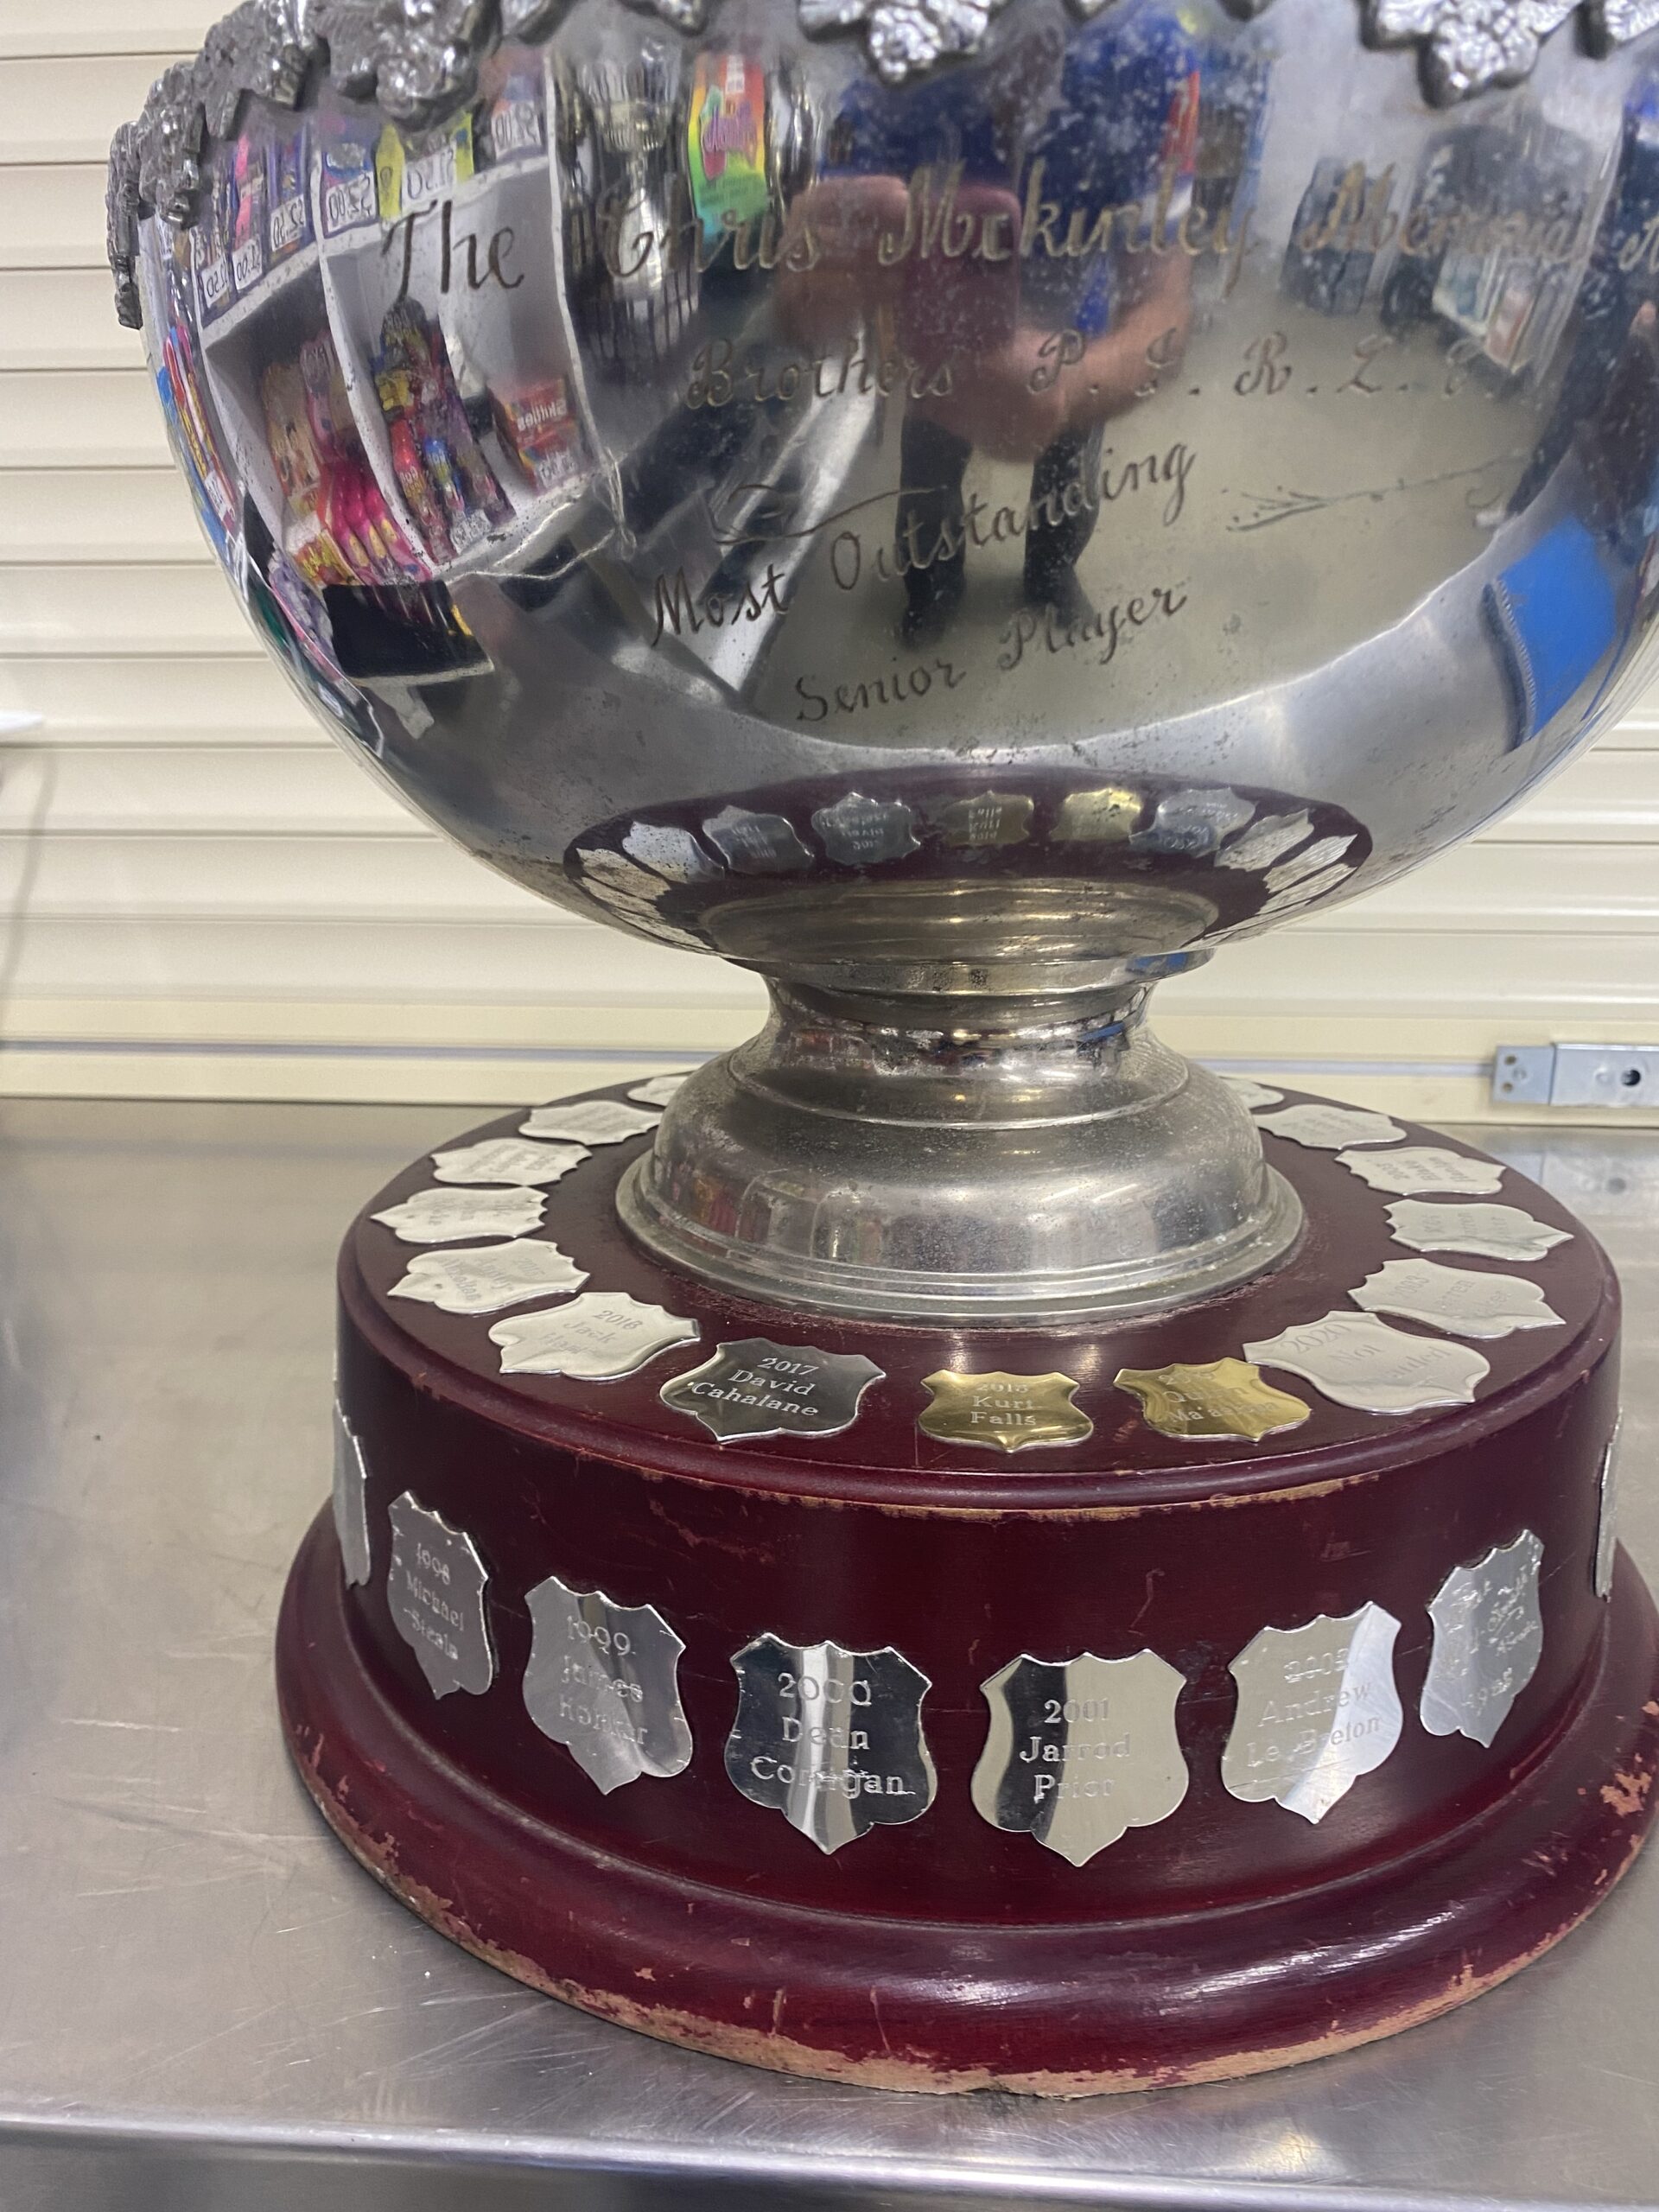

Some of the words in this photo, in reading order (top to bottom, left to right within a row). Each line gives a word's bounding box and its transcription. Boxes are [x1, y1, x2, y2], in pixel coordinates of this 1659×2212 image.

[381, 200, 525, 303] The
[685, 339, 953, 409] Brothers
[652, 563, 790, 647] Most
[830, 441, 1197, 589] Outstanding
[796, 657, 967, 721] Senior
[998, 582, 1189, 664] Player
[563, 1321, 616, 1344] Jack
[593, 1310, 644, 1331] 2016
[1281, 1323, 1352, 1354] 2020
[757, 1357, 820, 1376] 2017
[1329, 1344, 1385, 1365] Not
[728, 1369, 817, 1396] David
[691, 1381, 819, 1416] Cahalane
[973, 1395, 1033, 1409] Kurt
[970, 1411, 1037, 1426] Falls
[407, 1570, 464, 1631] Michael
[567, 1616, 631, 1656] 1999
[1044, 1698, 1110, 1725] 2001
[1258, 1681, 1373, 1727] Andrew
[1020, 1734, 1132, 1764] Jarrod
[1294, 1714, 1383, 1755] Breton
[1033, 1774, 1116, 1803] Prior
